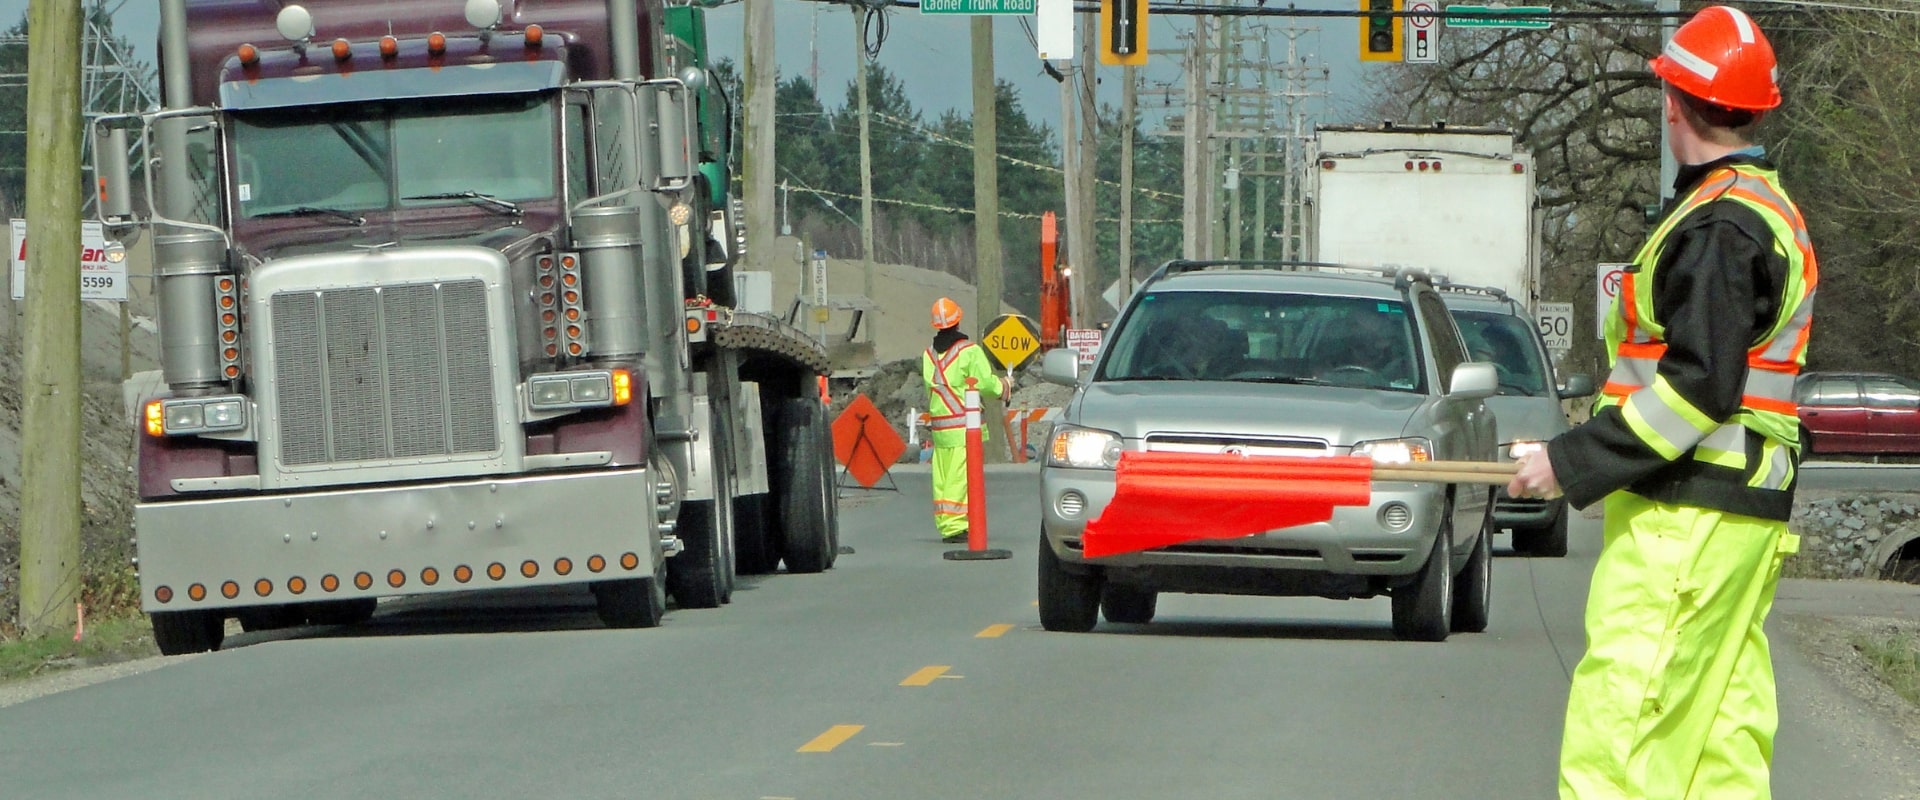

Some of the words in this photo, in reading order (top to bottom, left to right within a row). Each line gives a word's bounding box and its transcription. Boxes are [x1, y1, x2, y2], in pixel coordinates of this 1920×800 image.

[924, 0, 961, 10] Ladner
[968, 0, 998, 10] Trunk
[1004, 0, 1031, 10] Road
[815, 264, 824, 284] Stop
[816, 287, 824, 303] Bus
[1540, 316, 1568, 336] 50
[992, 335, 1031, 351] SLOW
[1070, 331, 1099, 340] DANGER
[1546, 337, 1568, 347] m/h
